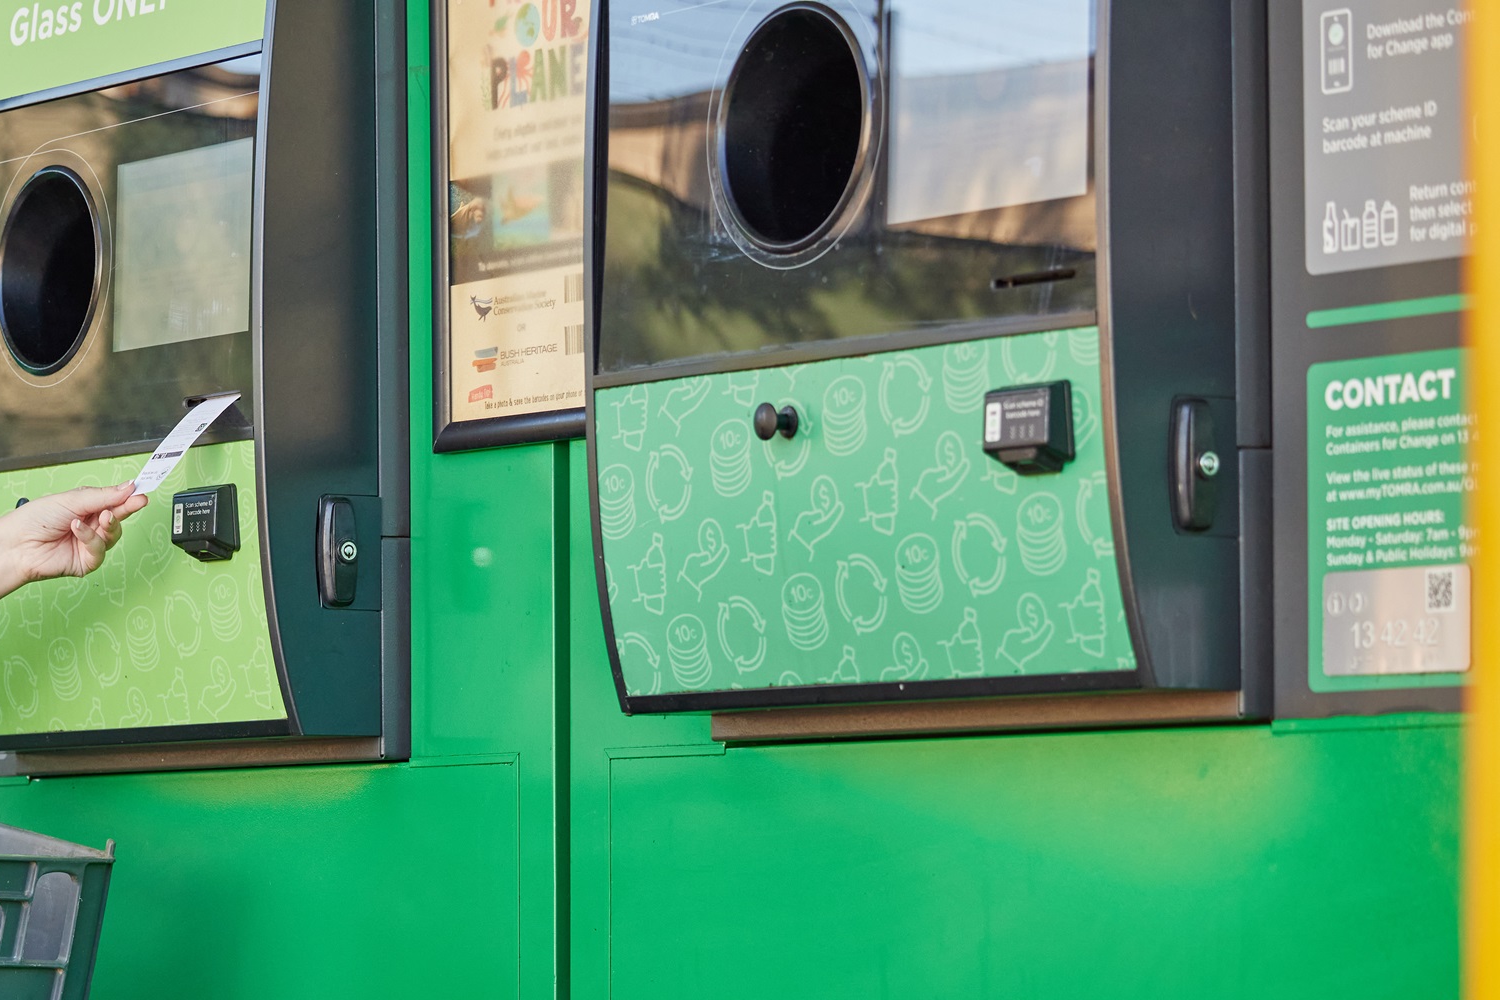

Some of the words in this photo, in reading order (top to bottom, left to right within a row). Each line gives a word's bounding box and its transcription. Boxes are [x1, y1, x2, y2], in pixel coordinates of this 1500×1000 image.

[9, 1, 83, 47] Glass
[92, 0, 166, 26] ON
[1367, 16, 1424, 39] Download
[1425, 12, 1445, 30] the
[1367, 43, 1384, 60] for
[1385, 36, 1429, 57] Change
[1430, 33, 1454, 51] app
[491, 42, 585, 111] PLANE
[1322, 116, 1350, 134] Scan
[1352, 112, 1376, 131] your
[1378, 104, 1422, 125] scheme
[1424, 100, 1438, 117] ID
[1322, 134, 1368, 155] barcode
[1370, 132, 1382, 147] at
[1384, 124, 1432, 146] machine
[500, 349, 520, 360] BUSH
[522, 344, 558, 358] HERITAGE
[832, 386, 856, 404] 10c
[1325, 369, 1456, 411] CONTACT
[719, 429, 742, 447] 10c
[1326, 425, 1344, 438] For
[1345, 420, 1400, 438] assistance,
[1401, 416, 1436, 432] please
[1326, 440, 1381, 456] Containers
[1382, 436, 1398, 450] for
[1399, 433, 1440, 450] Change
[1441, 433, 1456, 445] on
[1457, 429, 1469, 444] 13
[604, 474, 626, 491] 10c
[1326, 471, 1352, 485] View
[1353, 469, 1371, 483] the
[1372, 467, 1391, 481] live
[1392, 465, 1424, 480] status
[1425, 462, 1438, 477] of
[1438, 461, 1469, 476] these
[1326, 489, 1339, 503] at
[1026, 504, 1052, 524] 10c
[1326, 517, 1350, 532] SITE
[1351, 512, 1401, 530] OPENING
[1403, 509, 1445, 526] HOURS:
[1326, 534, 1367, 549] Monday
[1375, 529, 1424, 546] Saturday:
[1426, 527, 1449, 542] 7am
[905, 545, 929, 564] 10c
[1326, 552, 1365, 567] Sunday
[1365, 550, 1374, 564] &
[1375, 547, 1408, 563] Public
[1409, 544, 1456, 562] Holidays:
[790, 584, 814, 602] 10c
[674, 624, 697, 643] 10c
[1350, 620, 1375, 649] 13
[1380, 618, 1407, 647] 42
[1412, 616, 1440, 646] 42
